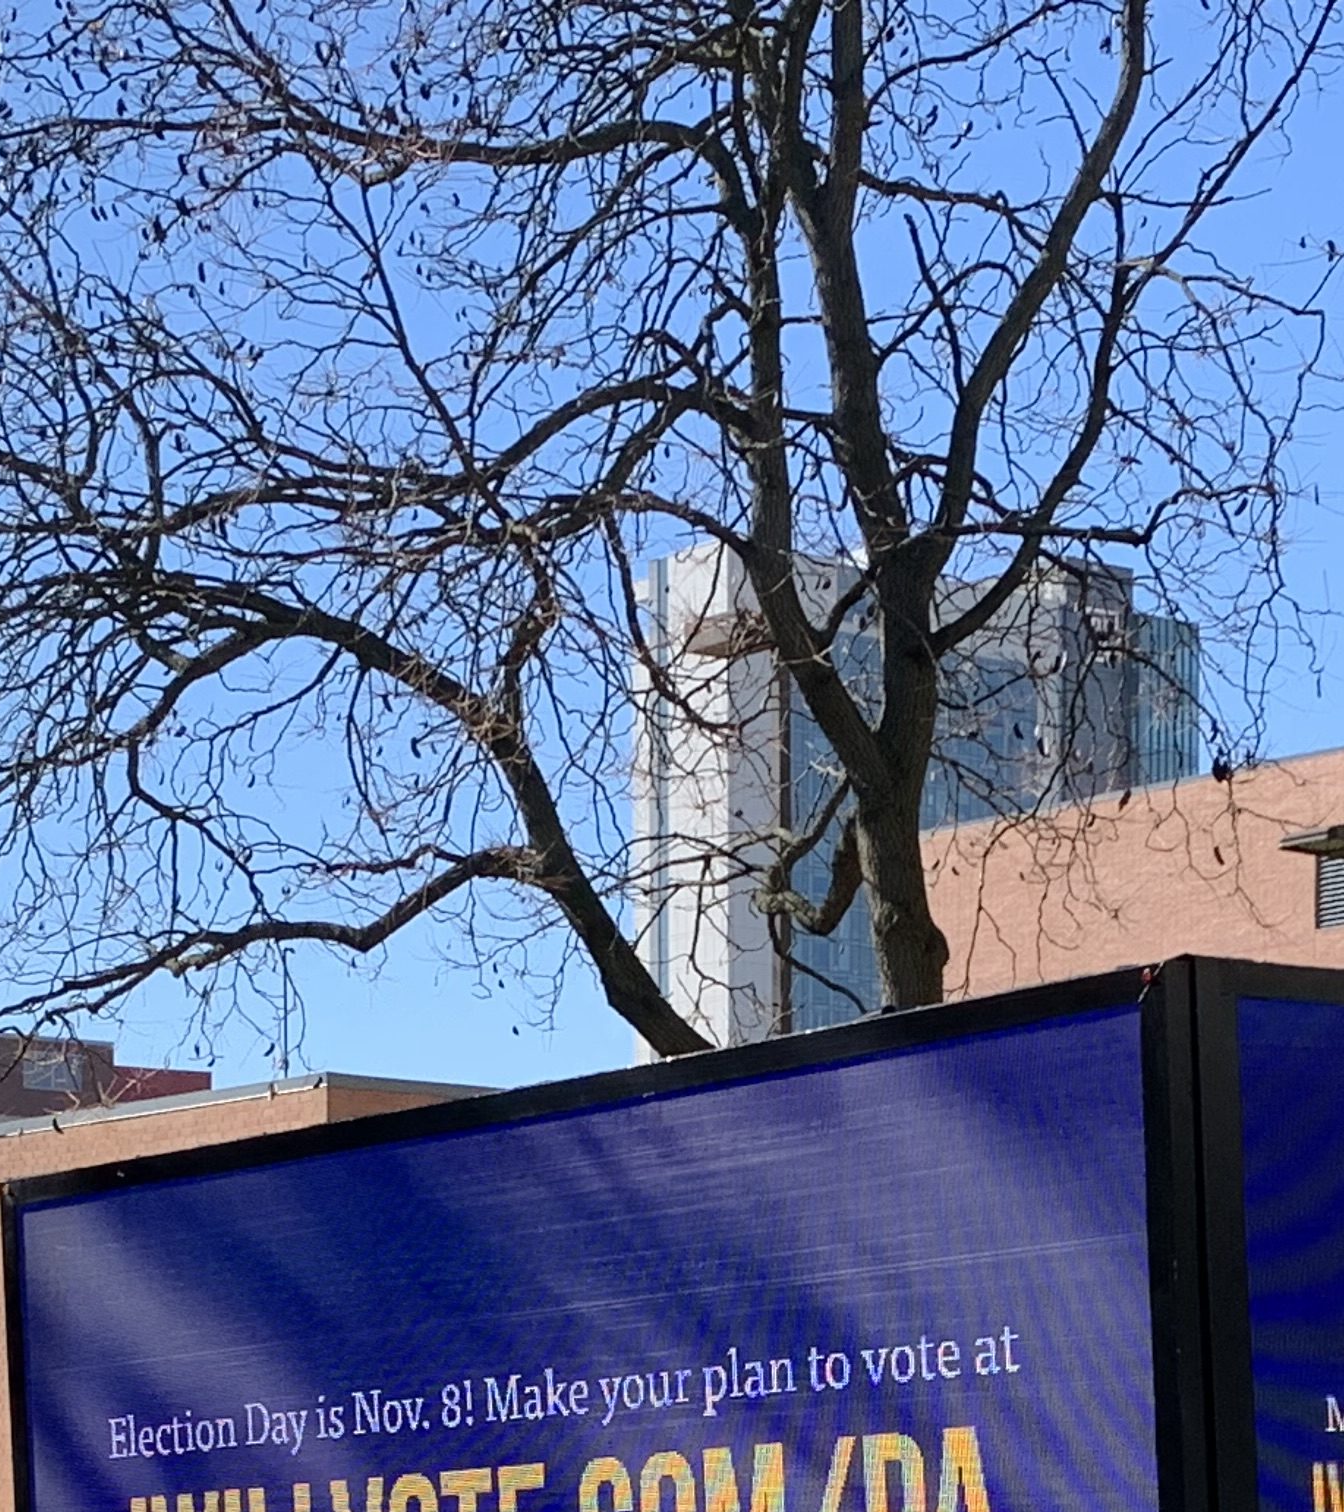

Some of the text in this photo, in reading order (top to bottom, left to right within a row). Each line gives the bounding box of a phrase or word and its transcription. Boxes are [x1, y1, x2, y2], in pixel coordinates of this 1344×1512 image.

[109, 1325, 1021, 1460] Election Day is Nov. 8! Make your plan to vote at
